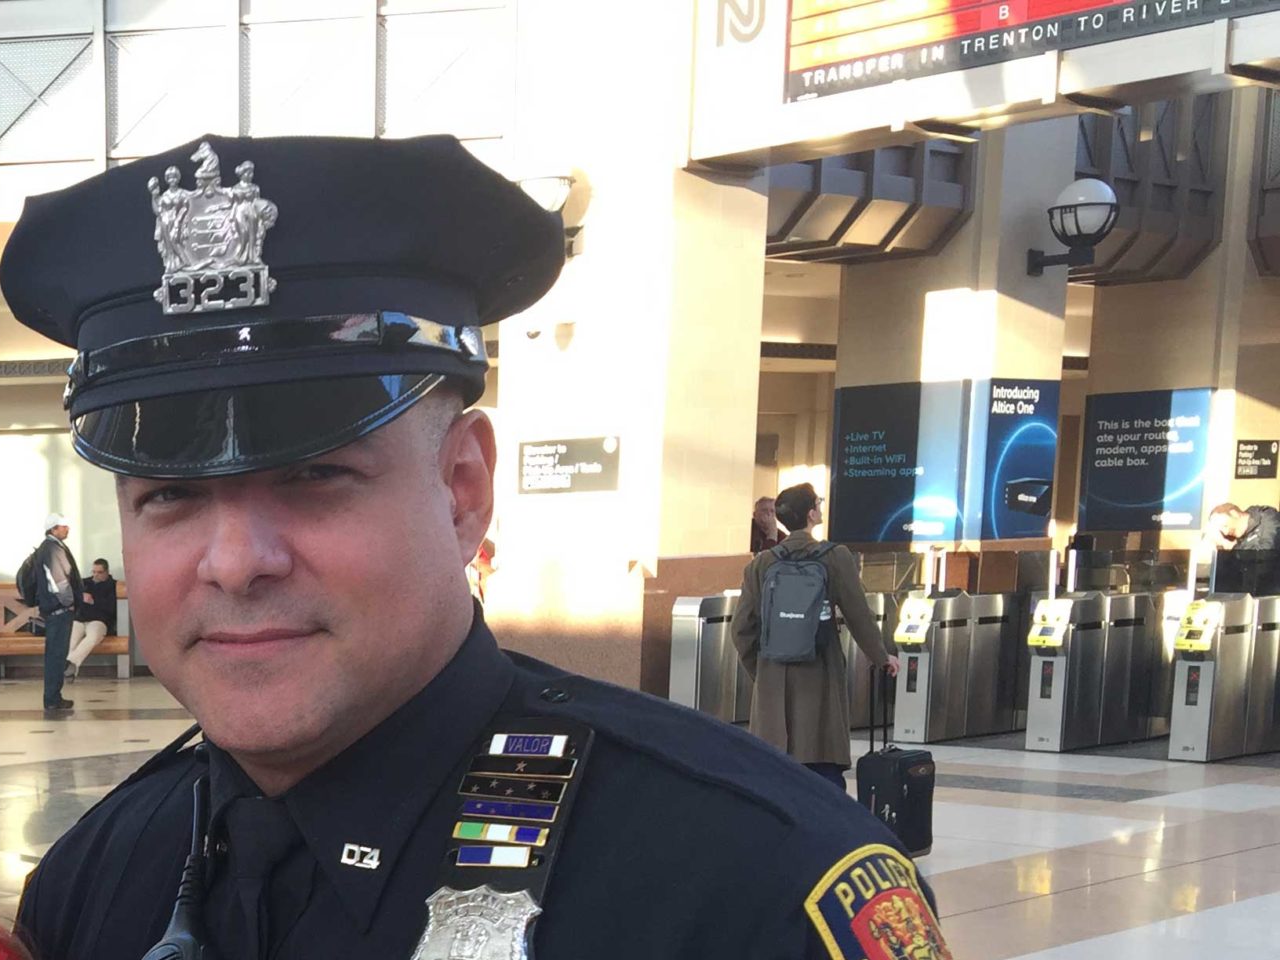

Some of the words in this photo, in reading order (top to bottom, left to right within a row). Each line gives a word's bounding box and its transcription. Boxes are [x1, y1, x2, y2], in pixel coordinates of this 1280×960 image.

[999, 5, 1010, 20] B
[802, 53, 904, 87] TRANSFER
[921, 44, 944, 64] IN
[961, 22, 1059, 54] TRENTON
[1078, 13, 1104, 31] TO
[1123, 0, 1198, 23] RIVER
[992, 384, 1041, 403] Introducing
[991, 400, 1016, 415] Altice
[1016, 400, 1035, 415] One
[1097, 420, 1119, 430] This
[1121, 419, 1130, 429] is
[1134, 418, 1151, 428] the
[872, 430, 885, 441] TV
[1096, 433, 1114, 443] ate
[1116, 433, 1141, 445] your
[1144, 430, 1180, 442] rout
[1095, 445, 1138, 456] modem,
[1140, 443, 1168, 455] apps
[1094, 457, 1123, 467] cable
[1126, 456, 1149, 467] box.
[508, 737, 550, 753] VALOR
